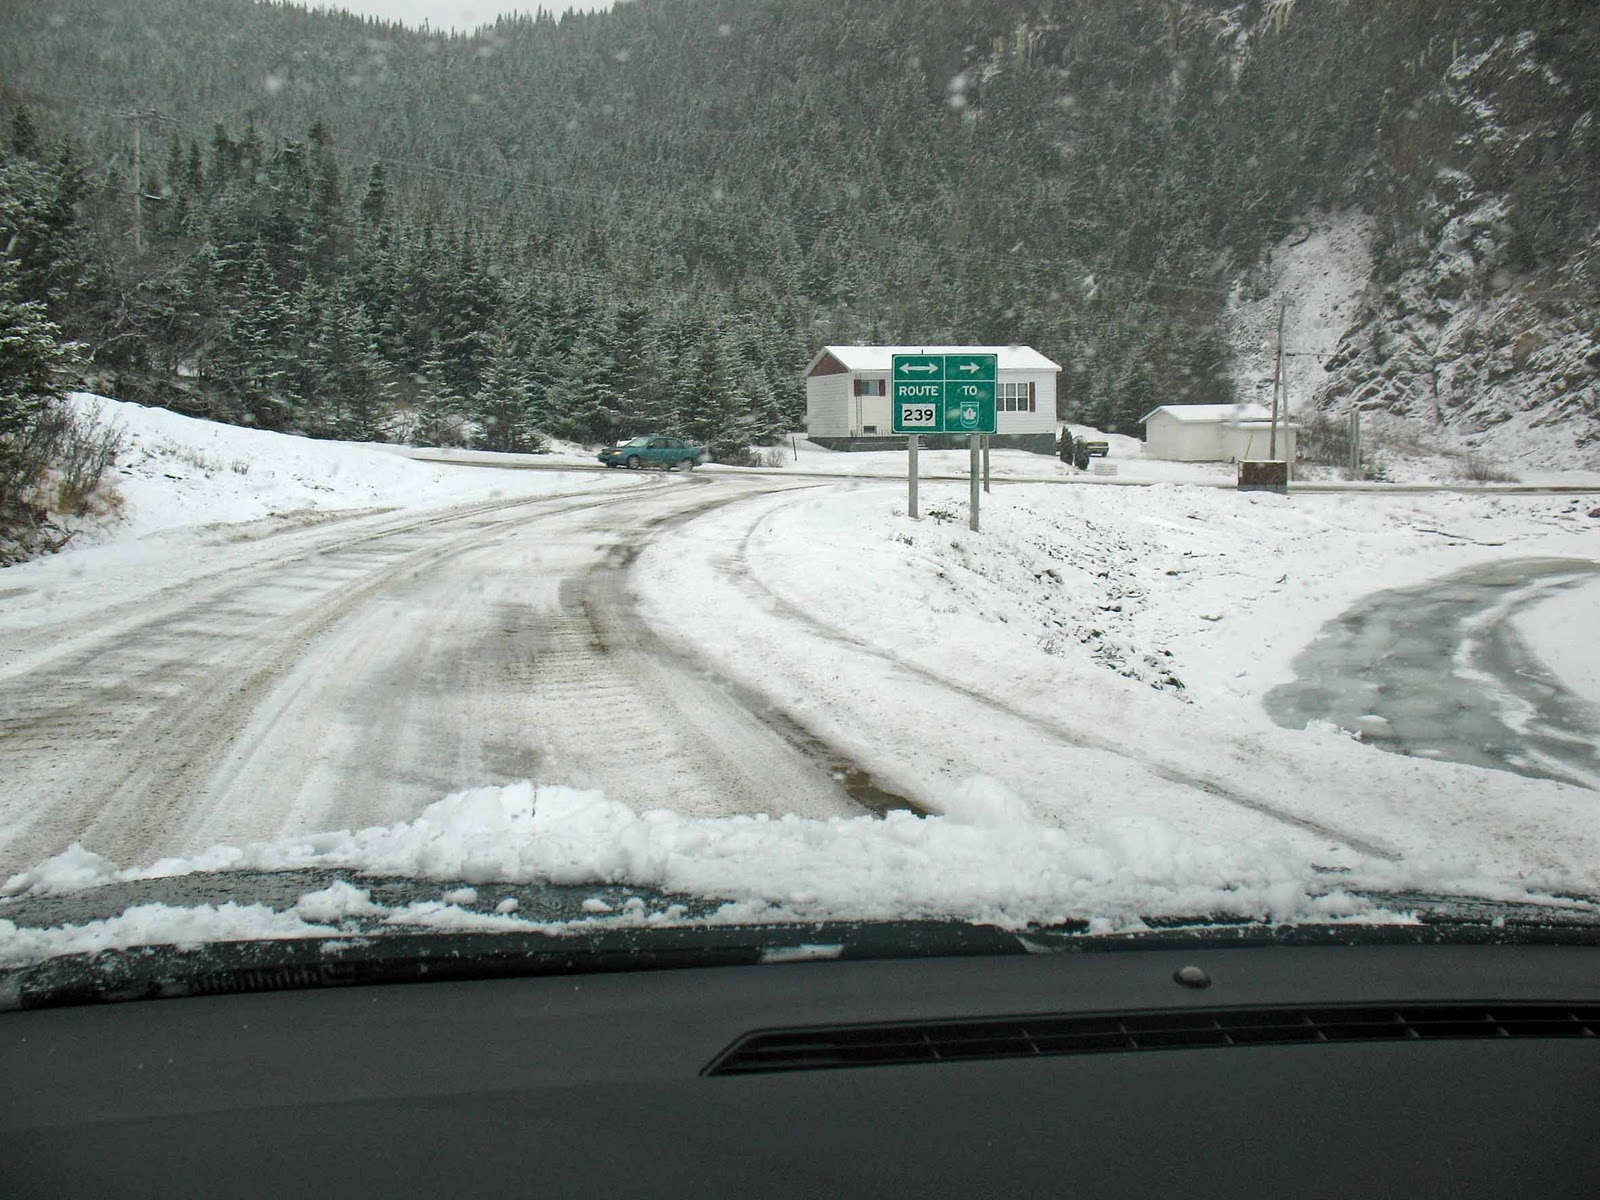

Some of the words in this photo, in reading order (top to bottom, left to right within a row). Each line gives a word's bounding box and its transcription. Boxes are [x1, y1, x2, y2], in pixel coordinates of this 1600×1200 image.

[899, 385, 939, 396] ROUTE
[962, 385, 978, 396] TO
[903, 409, 934, 421] 239
